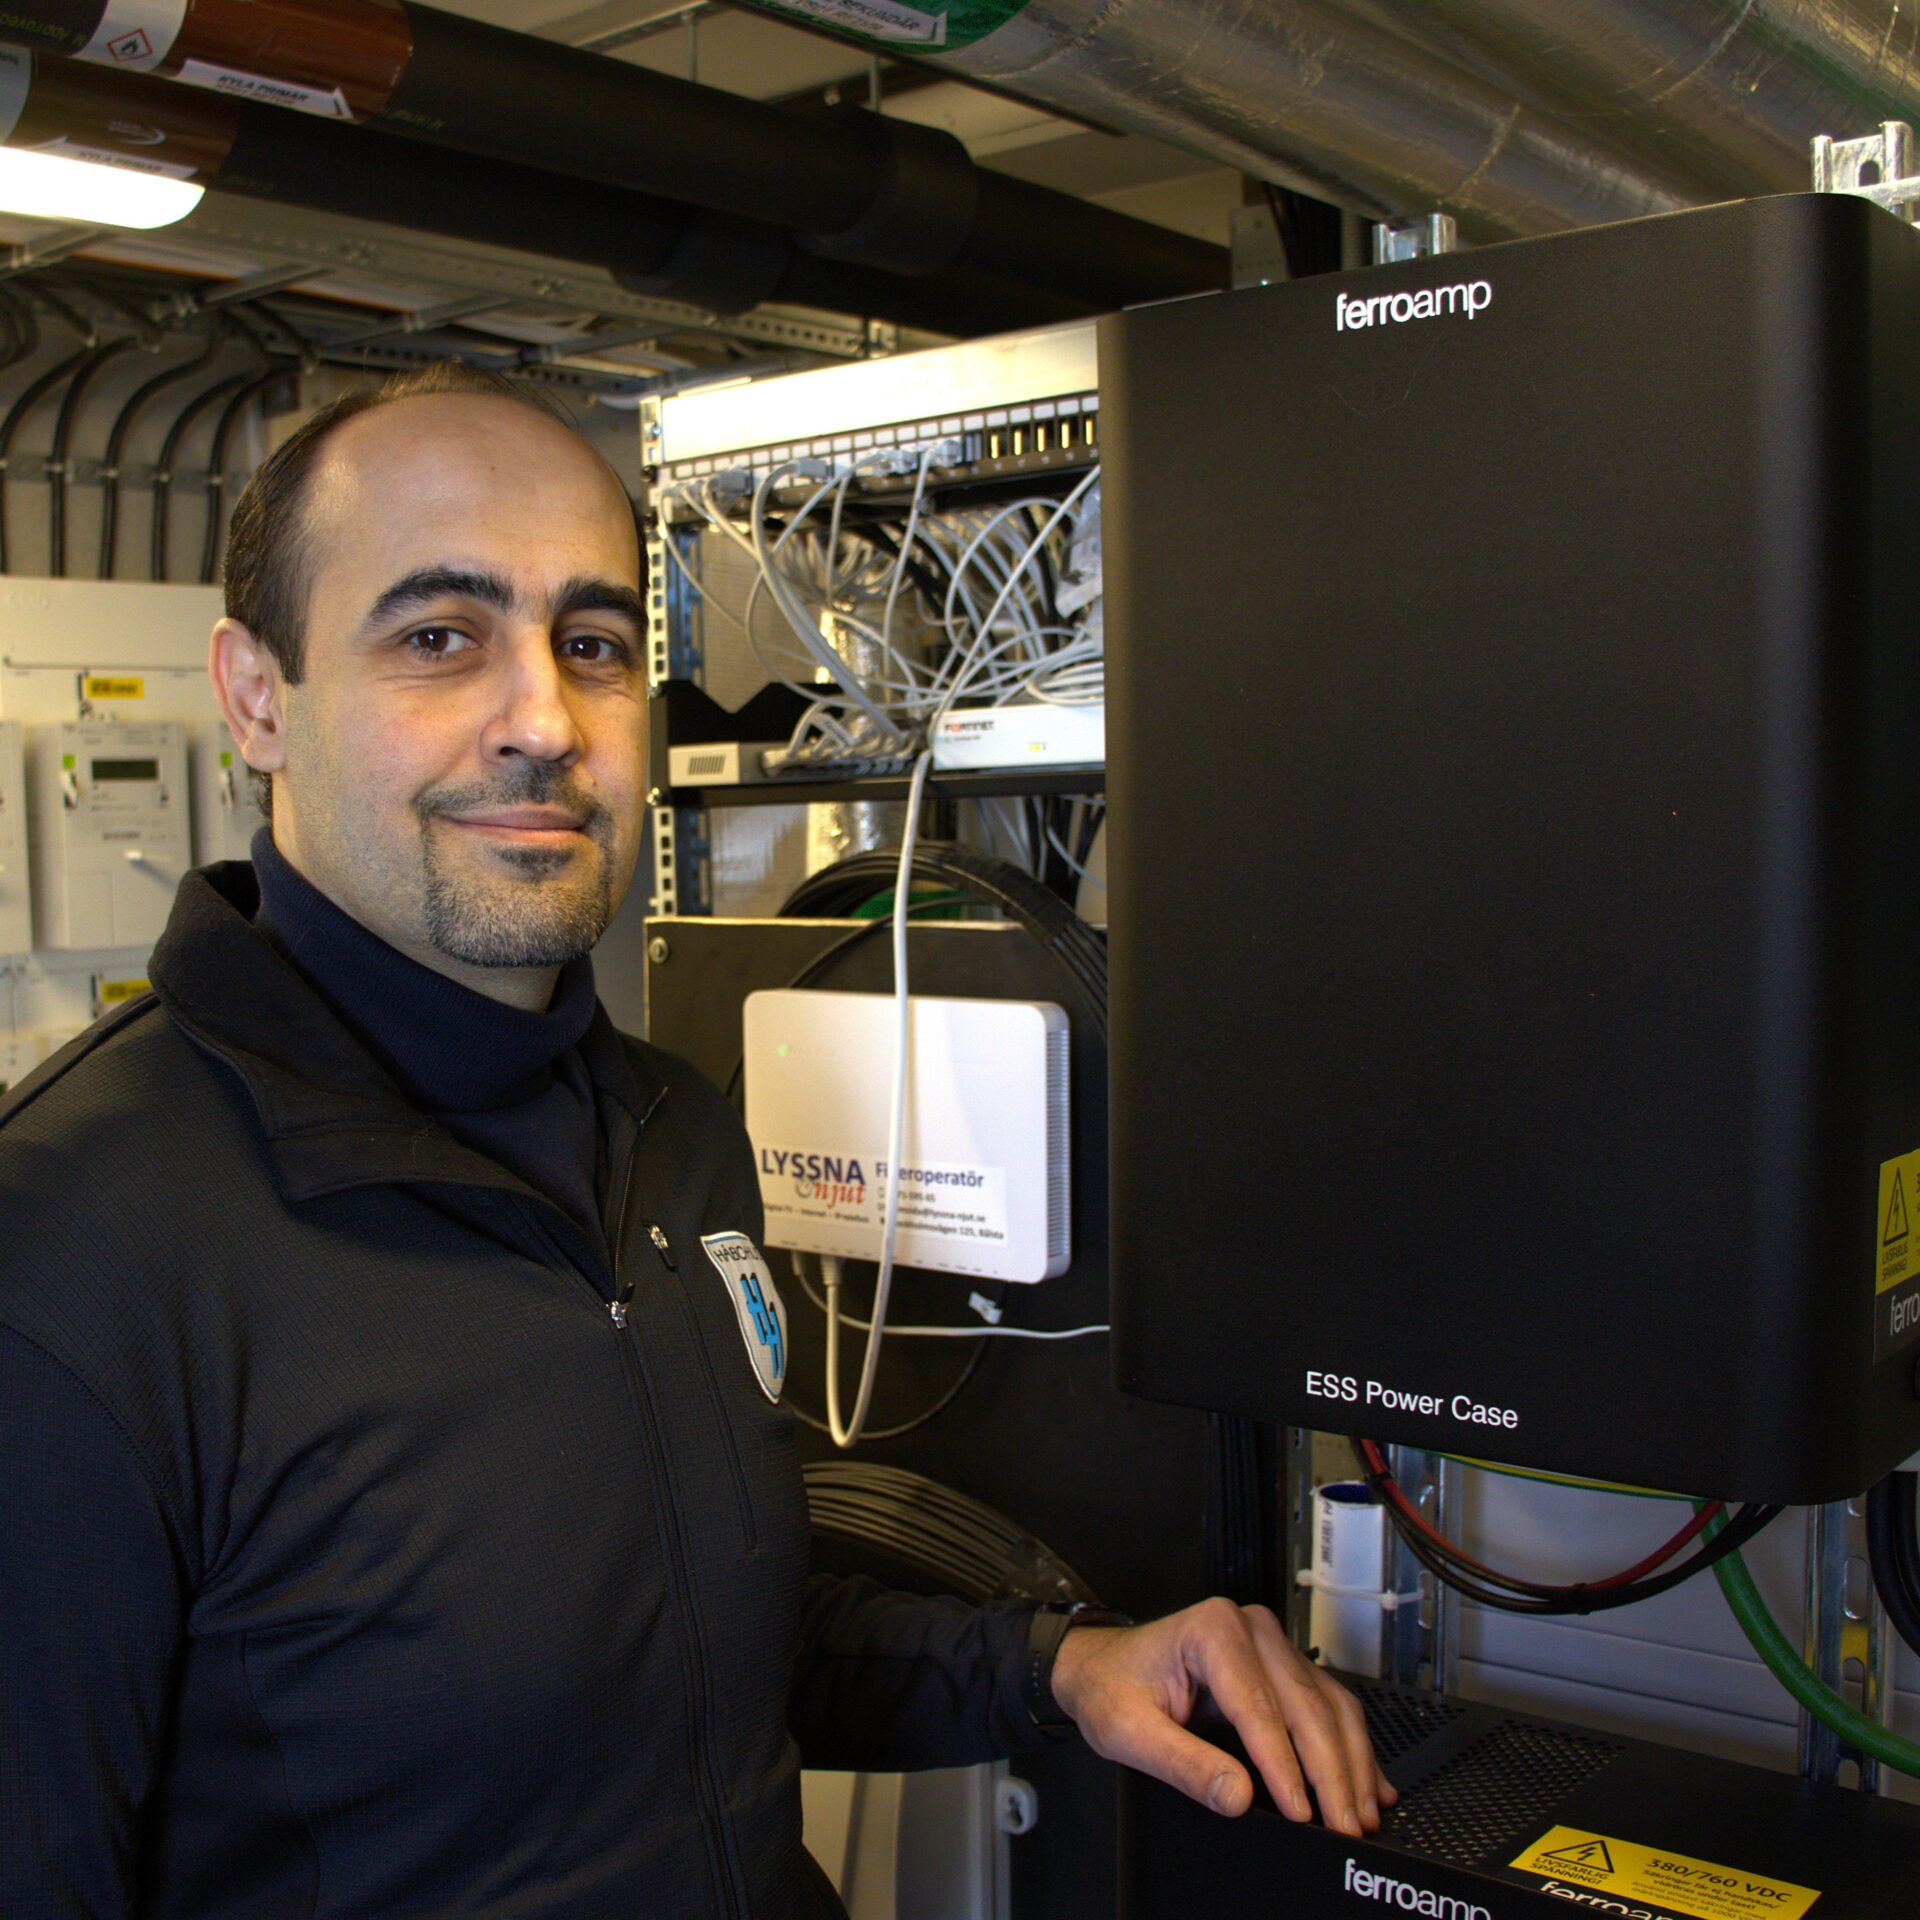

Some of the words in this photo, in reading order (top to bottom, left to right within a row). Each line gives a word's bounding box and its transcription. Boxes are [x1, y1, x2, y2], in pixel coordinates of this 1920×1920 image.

[1336, 280, 1492, 332] ferroamp
[762, 1149, 866, 1185] LYSSNA
[875, 1161, 985, 1188] Fieroperatör
[814, 1180, 866, 1209] njut
[1306, 1370, 1359, 1402] ESS
[1366, 1380, 1444, 1416] Power
[1451, 1395, 1519, 1429] Case
[1529, 1862, 1602, 1885] SPÄNNING!
[1534, 1856, 1609, 1880] LIVSFARLIG
[1647, 1858, 1738, 1888] 380/760
[1743, 1882, 1792, 1903] VDC
